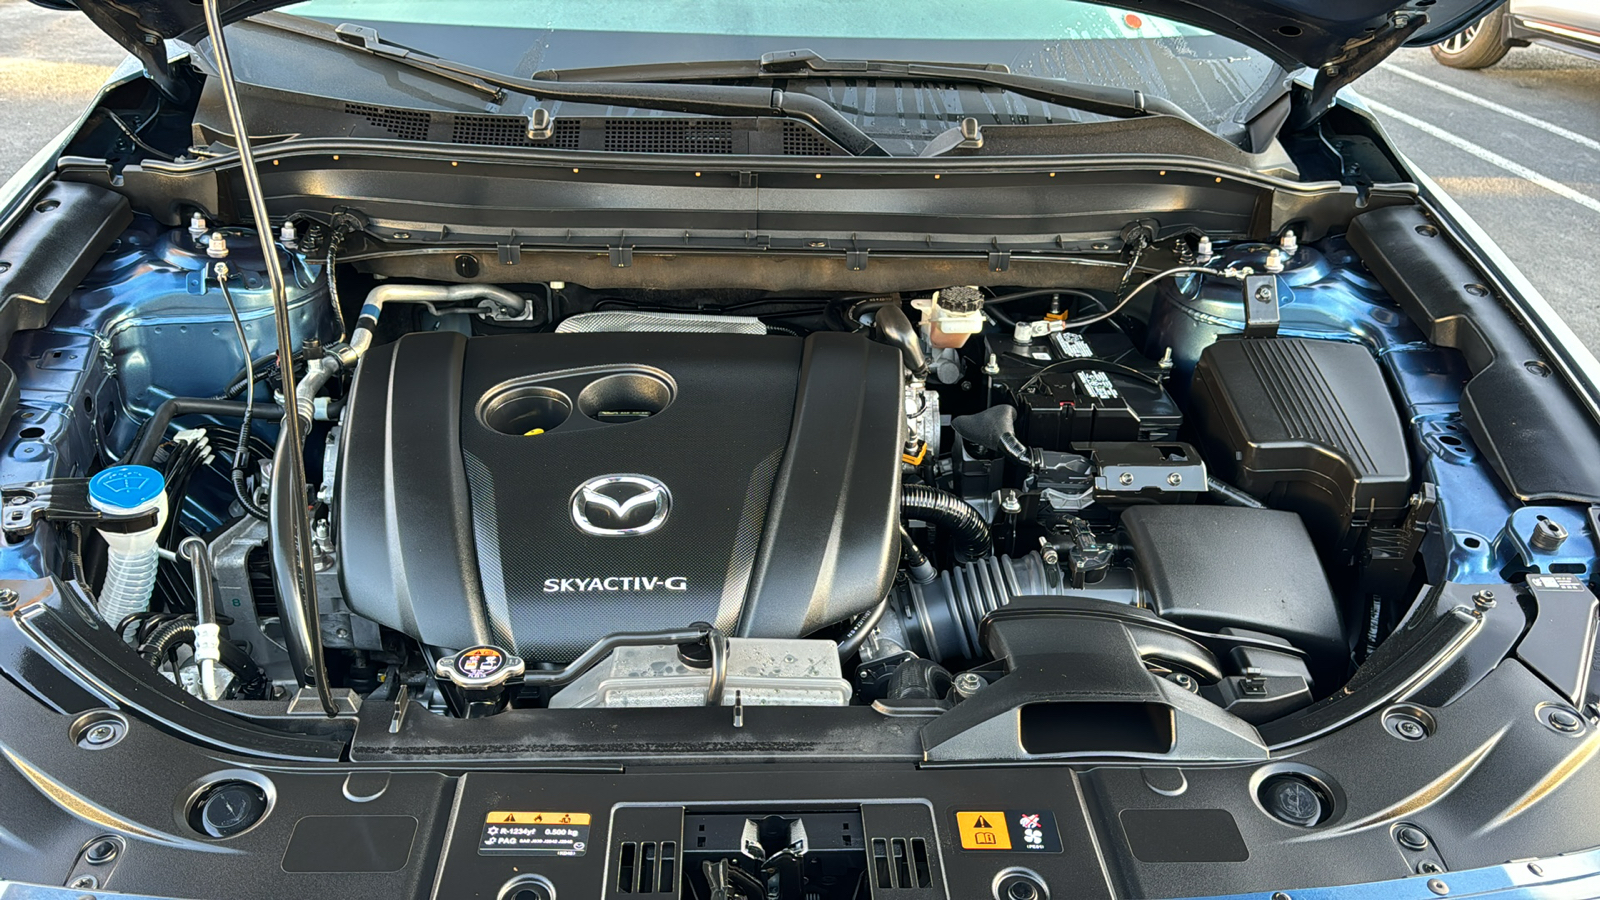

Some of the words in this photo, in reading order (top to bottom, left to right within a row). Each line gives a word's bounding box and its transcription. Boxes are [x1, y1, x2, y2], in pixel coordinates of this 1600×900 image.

[543, 577, 687, 592] SKYACTIV-G
[499, 828, 537, 836] R-1234yf
[567, 828, 579, 838] kg
[498, 837, 517, 845] PAG
